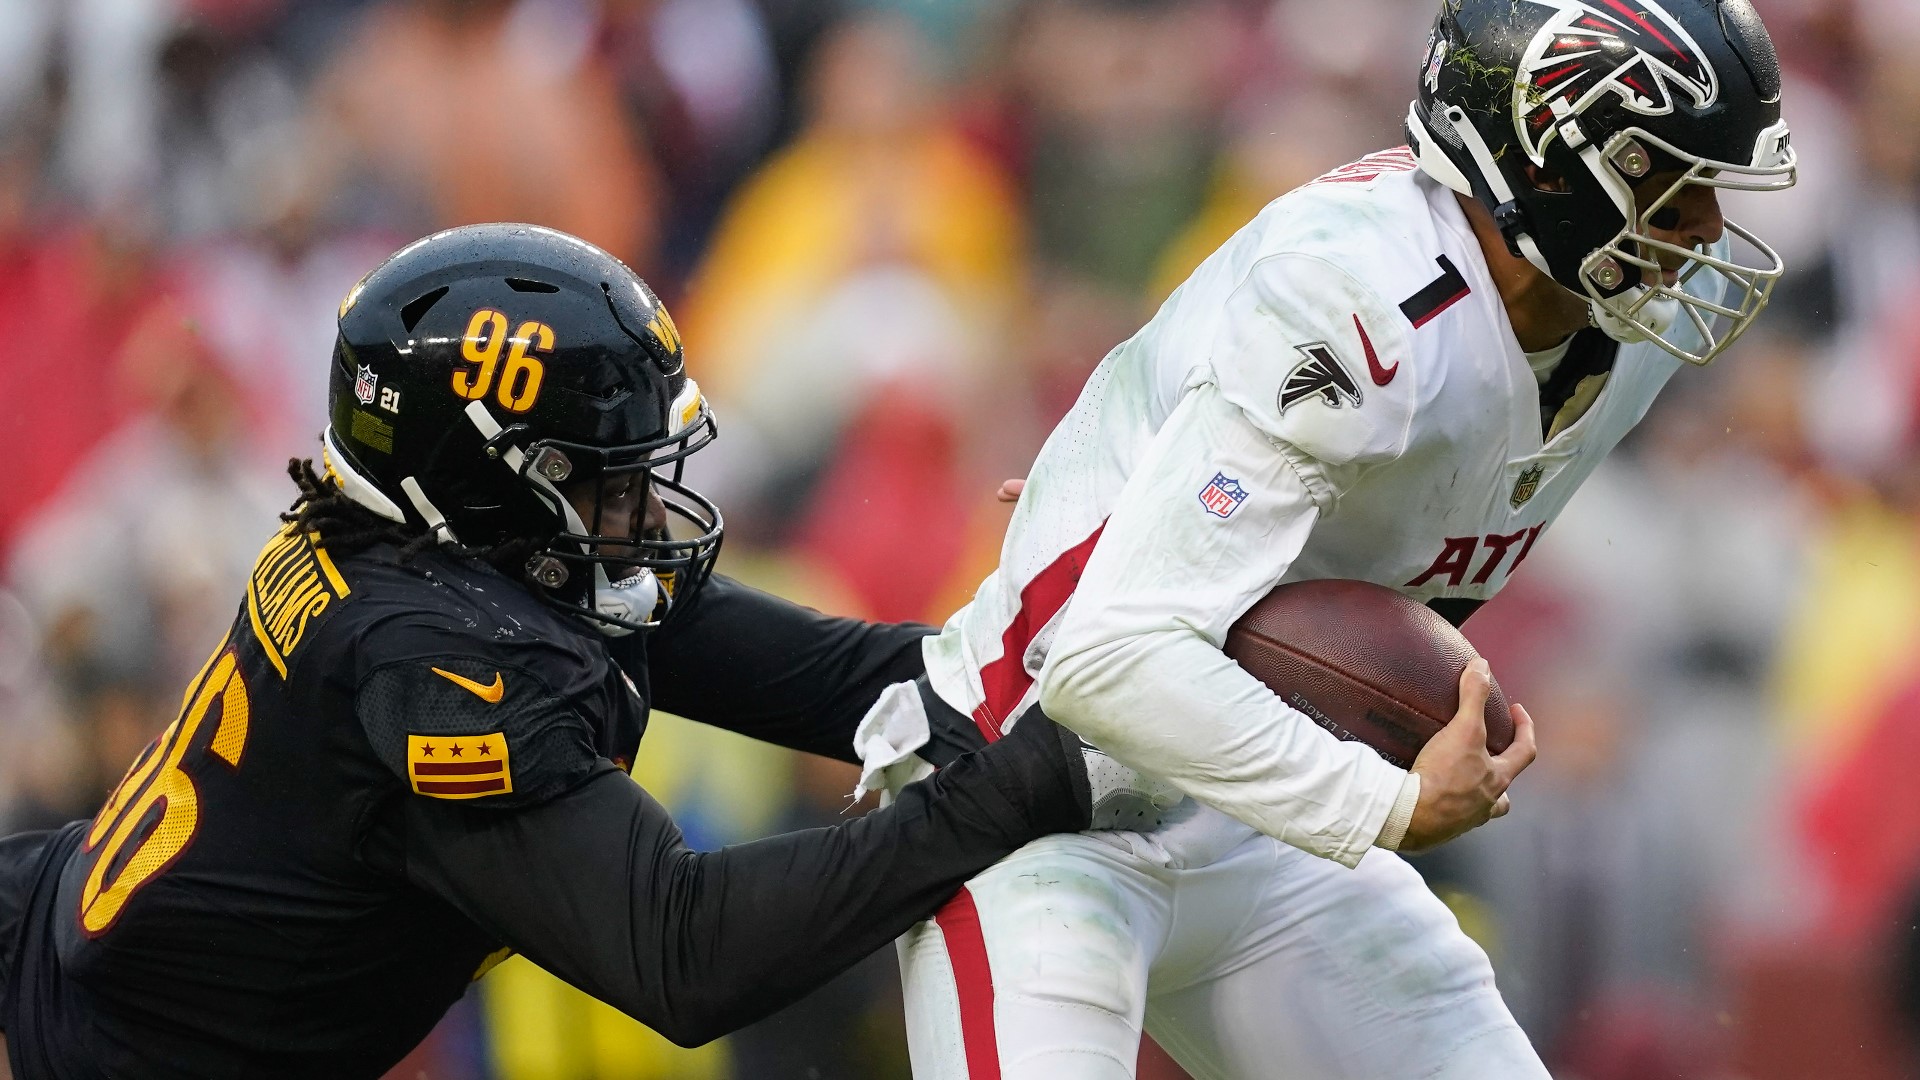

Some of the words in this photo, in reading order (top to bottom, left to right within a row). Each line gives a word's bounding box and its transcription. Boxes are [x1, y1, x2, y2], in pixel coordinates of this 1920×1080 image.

[1398, 253, 1471, 330] 1
[451, 307, 556, 414] 96
[357, 379, 372, 400] NFL
[380, 386, 400, 414] 21
[1202, 485, 1233, 515] NFL
[1291, 692, 1338, 732] LEAGUE
